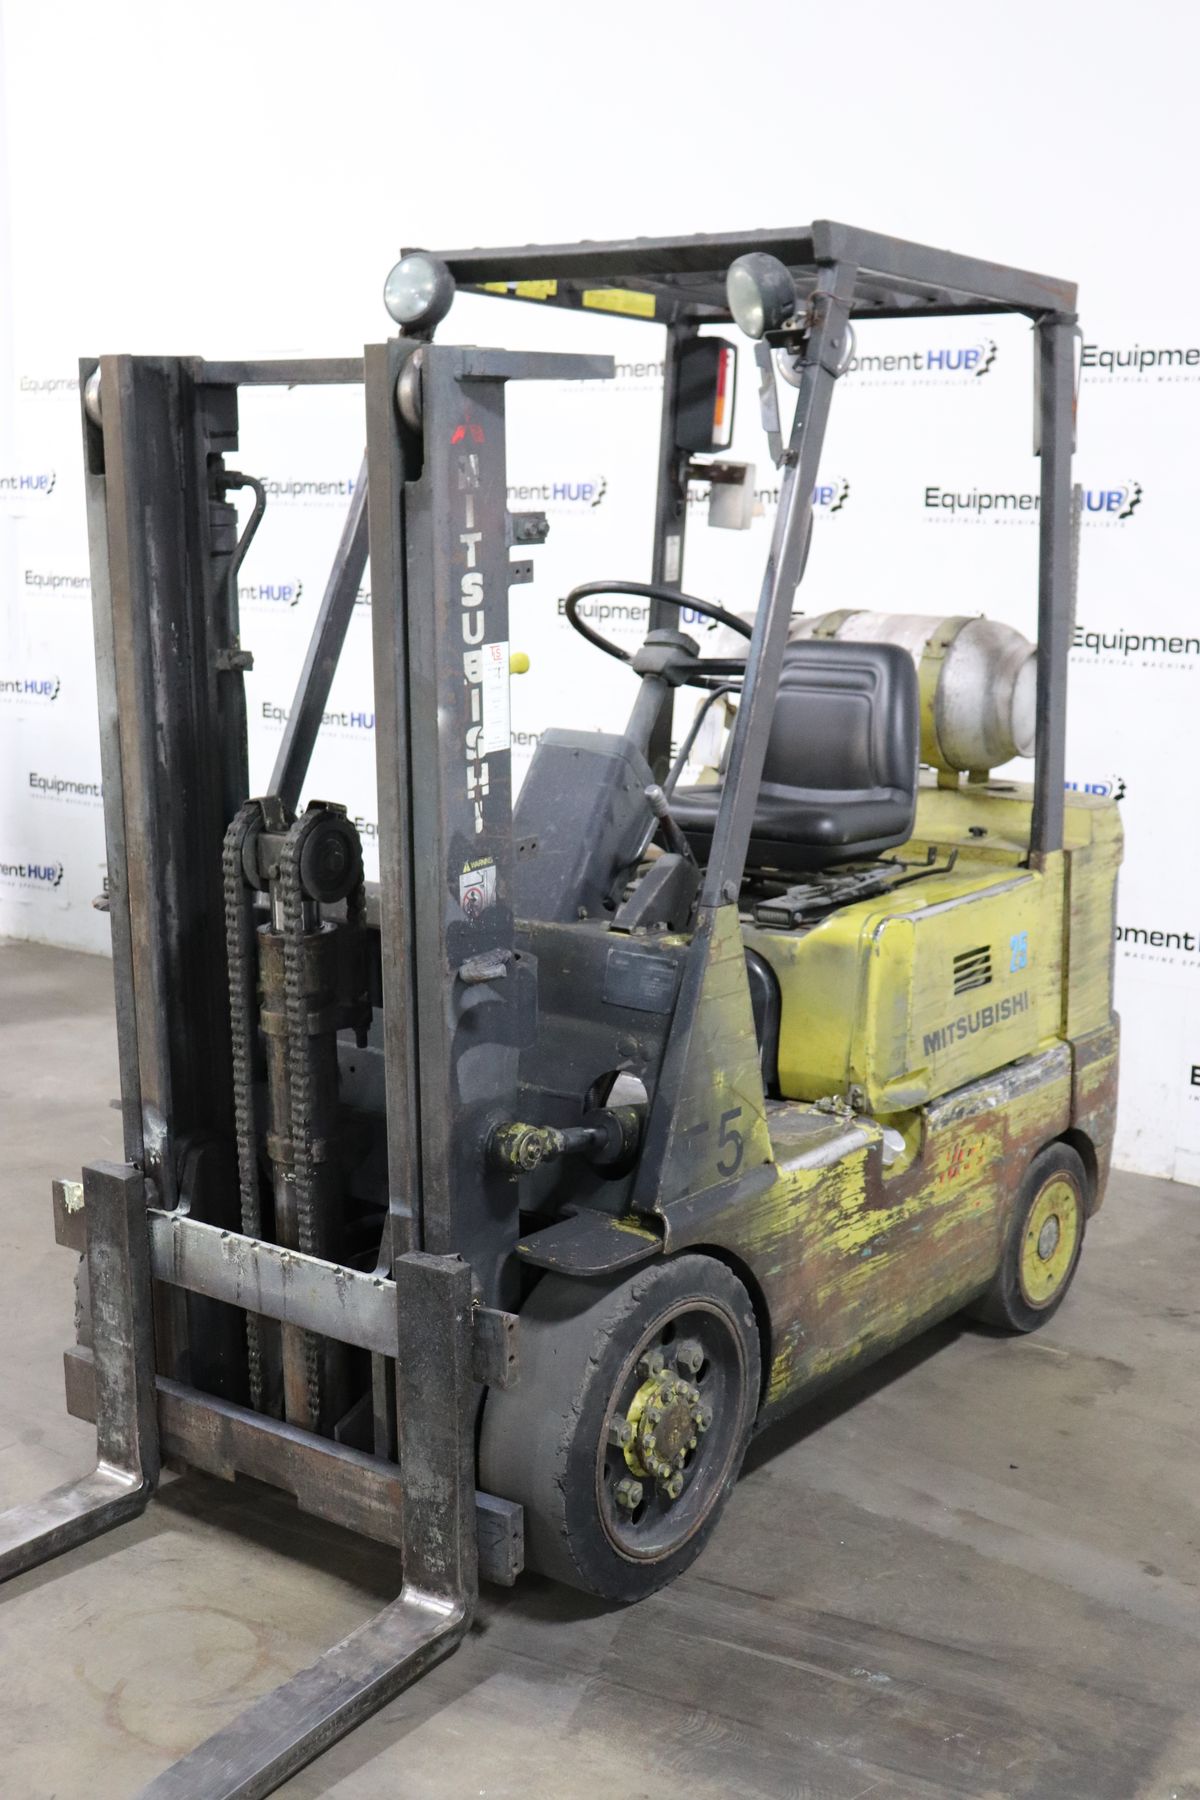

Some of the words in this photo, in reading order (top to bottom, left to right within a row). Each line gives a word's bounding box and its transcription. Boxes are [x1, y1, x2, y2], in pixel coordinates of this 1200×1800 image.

[846, 352, 923, 377] pment
[927, 349, 979, 370] HUB
[1081, 344, 1200, 373] Equipme
[20, 376, 79, 394] Equipme
[19, 475, 49, 490] HUB
[552, 483, 593, 501] HUB
[924, 487, 1040, 515] Equipme
[1080, 491, 1123, 511] UB
[25, 570, 91, 589] Equipmen
[259, 584, 293, 601] HUB
[1073, 627, 1200, 656] Equipmen
[24, 681, 51, 696] HUB
[350, 711, 375, 729] HU
[29, 772, 100, 798] Equipment
[27, 863, 55, 881] HUB
[923, 990, 1029, 1057] MITSUBISHI
